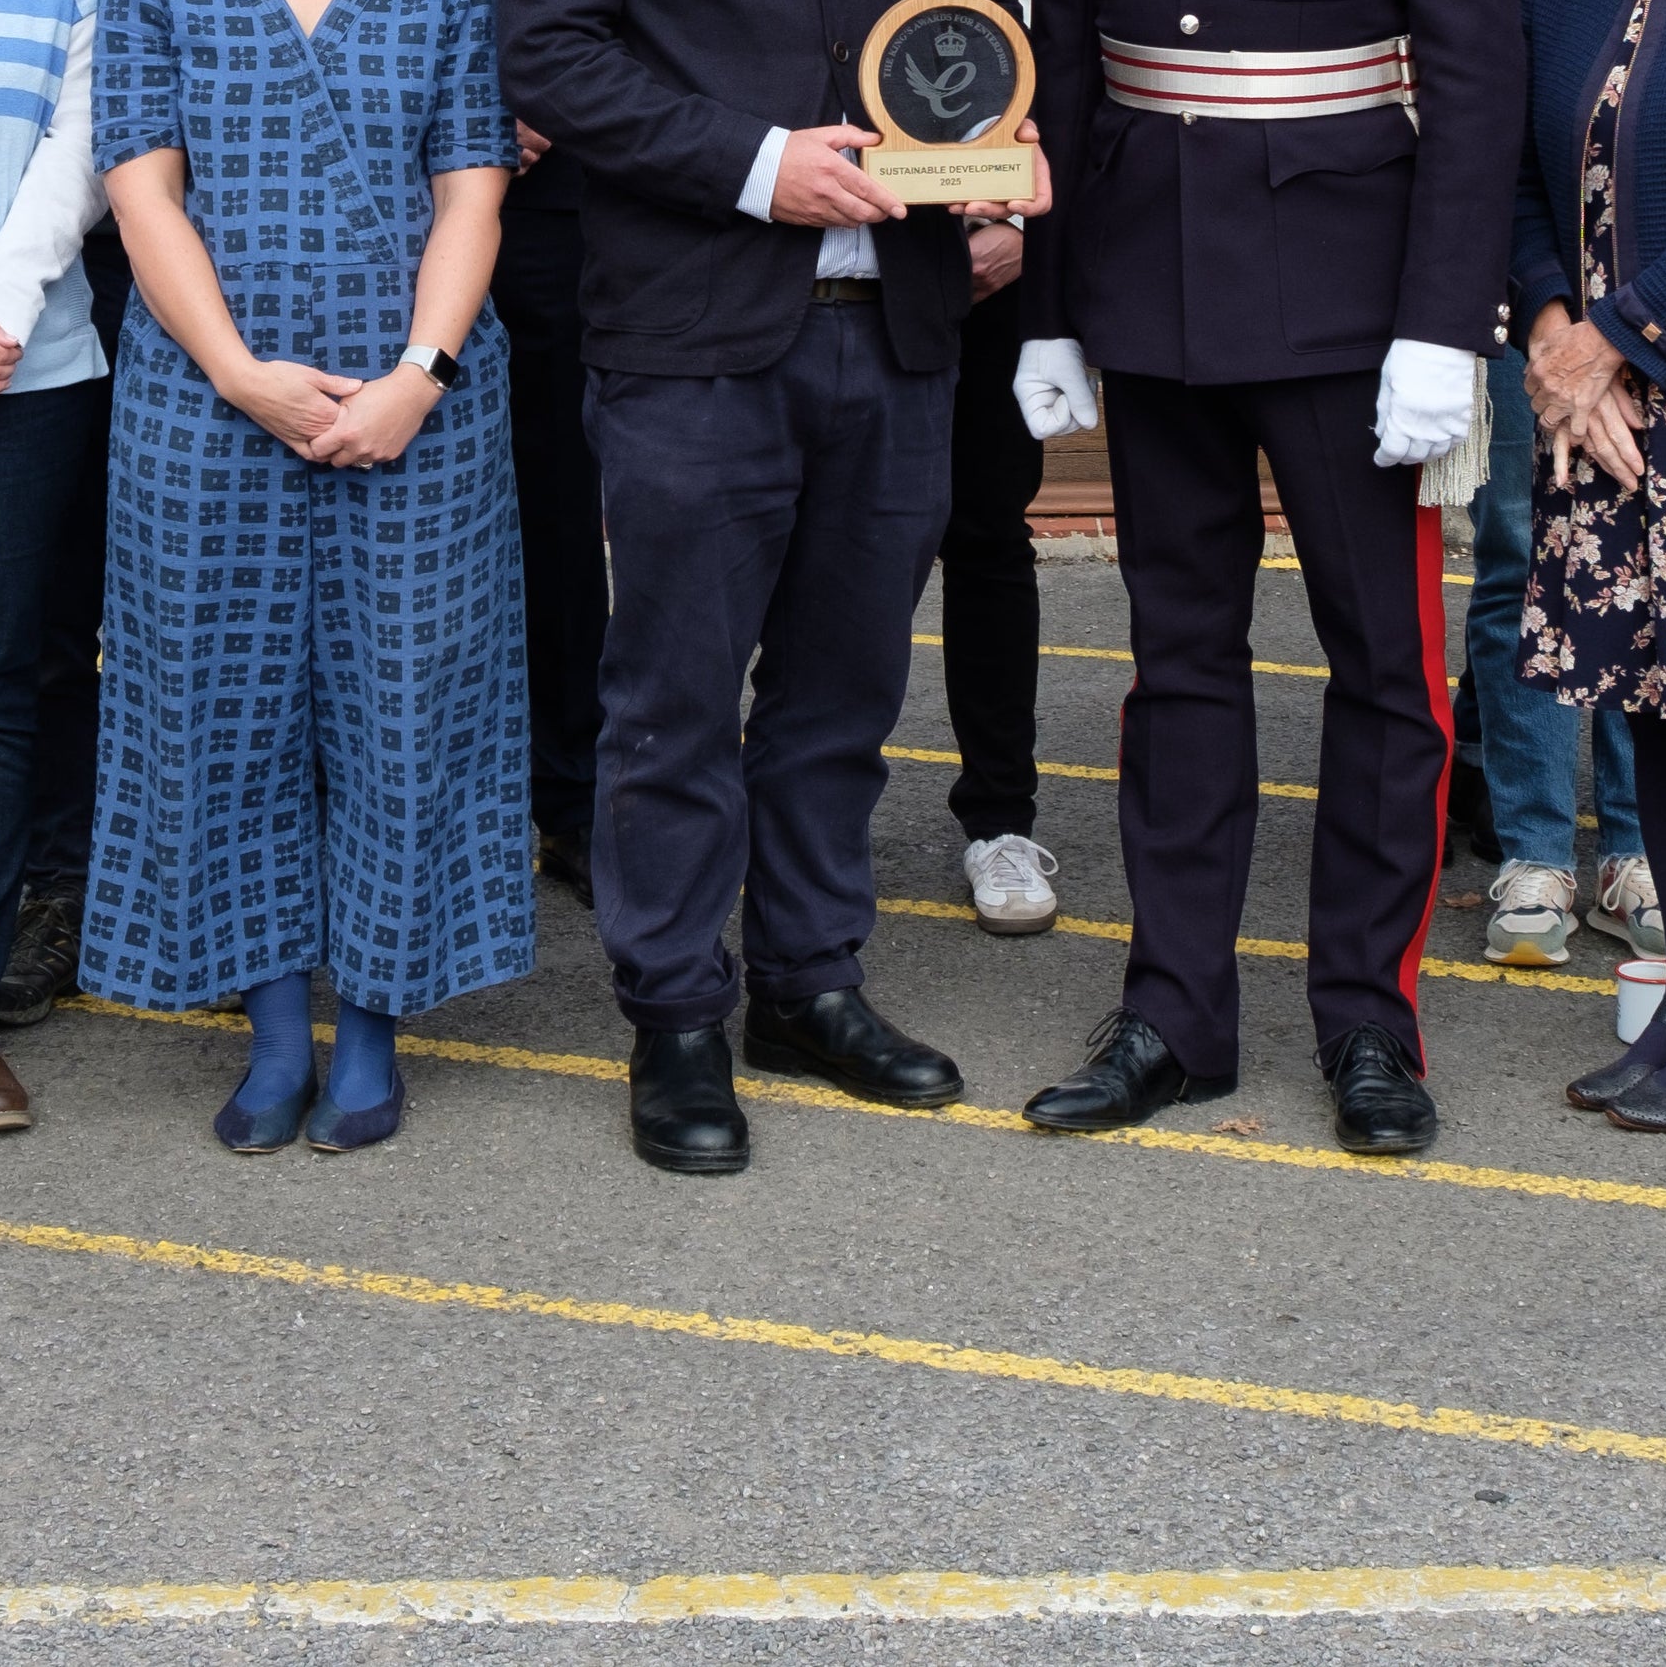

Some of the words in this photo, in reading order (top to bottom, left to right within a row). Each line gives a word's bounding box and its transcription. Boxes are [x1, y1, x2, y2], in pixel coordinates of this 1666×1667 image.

[883, 54, 894, 78] THE
[914, 13, 952, 32] AWARDS
[953, 14, 974, 28] FOR
[976, 20, 1010, 76] ENTERPRISE
[879, 166, 946, 176] SUSTAINABLE
[949, 164, 1022, 174] DEVELOPMENT
[940, 178, 962, 186] 2025
